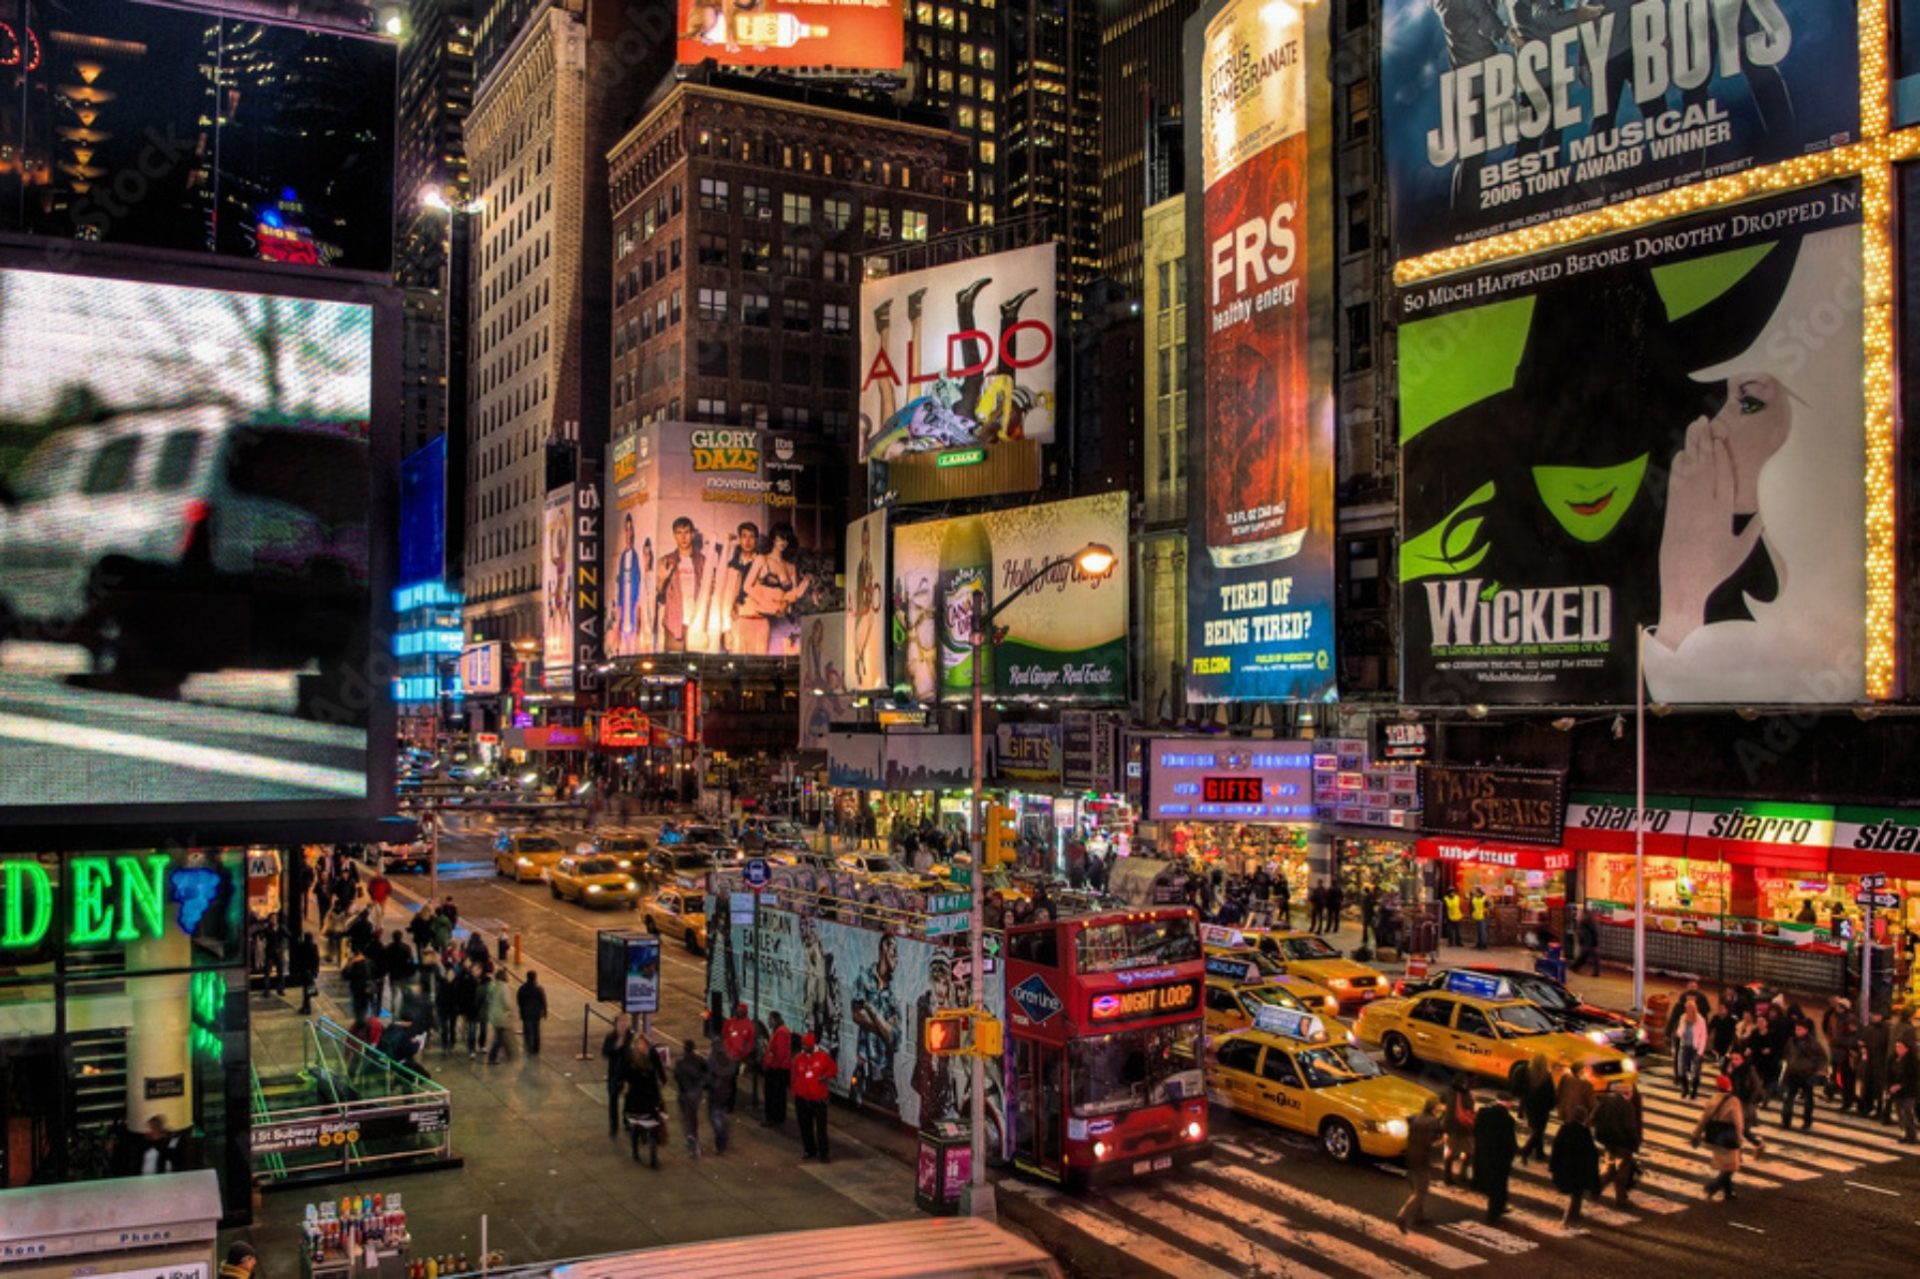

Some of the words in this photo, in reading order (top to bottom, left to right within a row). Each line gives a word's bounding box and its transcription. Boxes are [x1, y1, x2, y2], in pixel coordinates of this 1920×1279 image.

[1426, 12, 1617, 168] JERSEY
[1631, 0, 1793, 104] BOYS
[1479, 145, 1560, 189] BEST
[1569, 98, 1729, 163] MUSICAL
[1479, 179, 1522, 210] 2006
[1525, 165, 1573, 197] TONY
[1575, 146, 1643, 184] AWARD
[1649, 121, 1732, 160] WINNER
[1508, 211, 1551, 231] WILSON
[1635, 177, 1671, 195] WEST
[1212, 202, 1296, 307] FRS
[1212, 298, 1252, 334] healthy
[1255, 278, 1299, 312] energy
[862, 319, 1053, 393] ALDO
[691, 429, 757, 449] GLORY
[706, 476, 773, 491] november
[776, 479, 791, 493] 16
[763, 491, 798, 508] 10pm
[1002, 557, 1038, 596] Holly
[1220, 580, 1268, 611] TIRED
[1271, 576, 1293, 605] OF
[1204, 617, 1249, 647] BEING
[1252, 611, 1313, 643] TIRED?
[1192, 656, 1231, 675] FRS.COM
[1008, 737, 1051, 758] GIFTS
[1205, 780, 1261, 800] GIFTS
[1471, 797, 1553, 830] STEAKS
[1580, 802, 1671, 833] sbarro
[1708, 807, 1812, 843] sbarro
[1853, 818, 1920, 852] sba
[1121, 990, 1157, 1014] NIGHT
[1160, 984, 1192, 1007] LOOP
[274, 1126, 318, 1141] Subway
[320, 1120, 361, 1134] Station
[3, 1243, 46, 1256] hone
[120, 1231, 171, 1244] Phone
